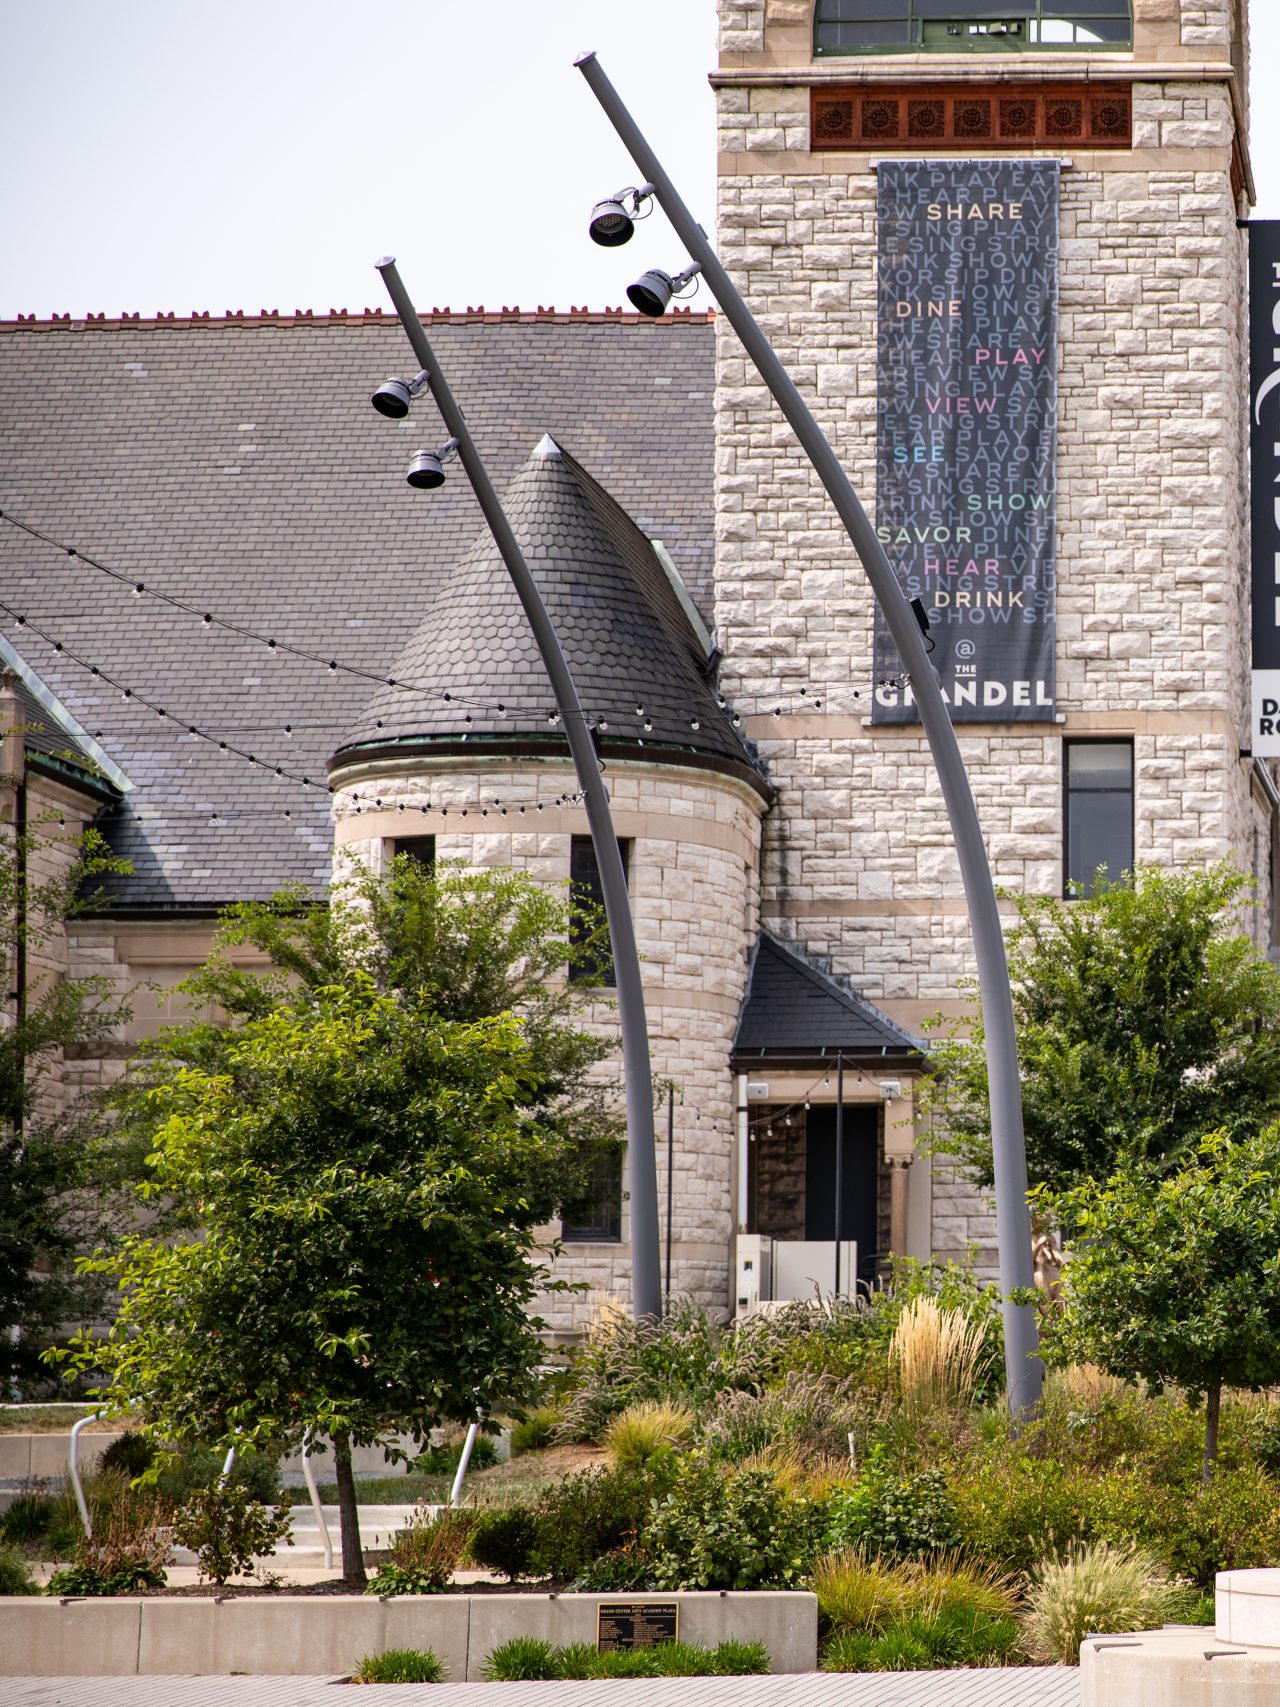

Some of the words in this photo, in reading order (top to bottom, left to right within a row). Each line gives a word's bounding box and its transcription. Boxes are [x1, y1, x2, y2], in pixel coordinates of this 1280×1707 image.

[931, 172, 1000, 188] PLAY
[896, 188, 971, 204] HEAR
[983, 187, 1053, 204] PLAY
[927, 203, 1023, 220] SHARE
[895, 220, 962, 237] SING
[974, 219, 1044, 236] PLAY
[910, 236, 977, 252] SING
[949, 252, 1033, 268] SHOW
[944, 268, 989, 285] SIP
[931, 284, 1015, 301] SHOW
[896, 300, 962, 317] DINE
[972, 300, 1041, 317] SING
[889, 316, 964, 334] HEAR
[976, 316, 1045, 333] PLAY
[927, 333, 1021, 350] SHARE
[888, 350, 964, 366] HEAR
[975, 348, 1045, 365] PLAY
[937, 365, 1008, 382] VIEW
[895, 381, 961, 398] SING
[973, 380, 1043, 397] PLAY
[925, 397, 997, 414] VIEW
[908, 413, 975, 430] SING
[957, 429, 1027, 446] PLAY
[894, 445, 945, 463] SEE
[955, 445, 1050, 462] SAVOR
[925, 462, 1021, 479] SHARE
[908, 478, 975, 495] SING
[967, 493, 1051, 511] SHOW
[929, 510, 1013, 527] SHOW
[877, 526, 972, 543] SAVOR
[983, 526, 1049, 543] DINE
[892, 543, 963, 560] VIEW
[974, 542, 1044, 559] PLAY
[924, 559, 1000, 576] HEAR
[906, 575, 974, 592] SING
[934, 591, 1024, 608] DRINK
[928, 607, 1012, 624] SHOW
[955, 639, 976, 660] @
[955, 664, 977, 674] THE
